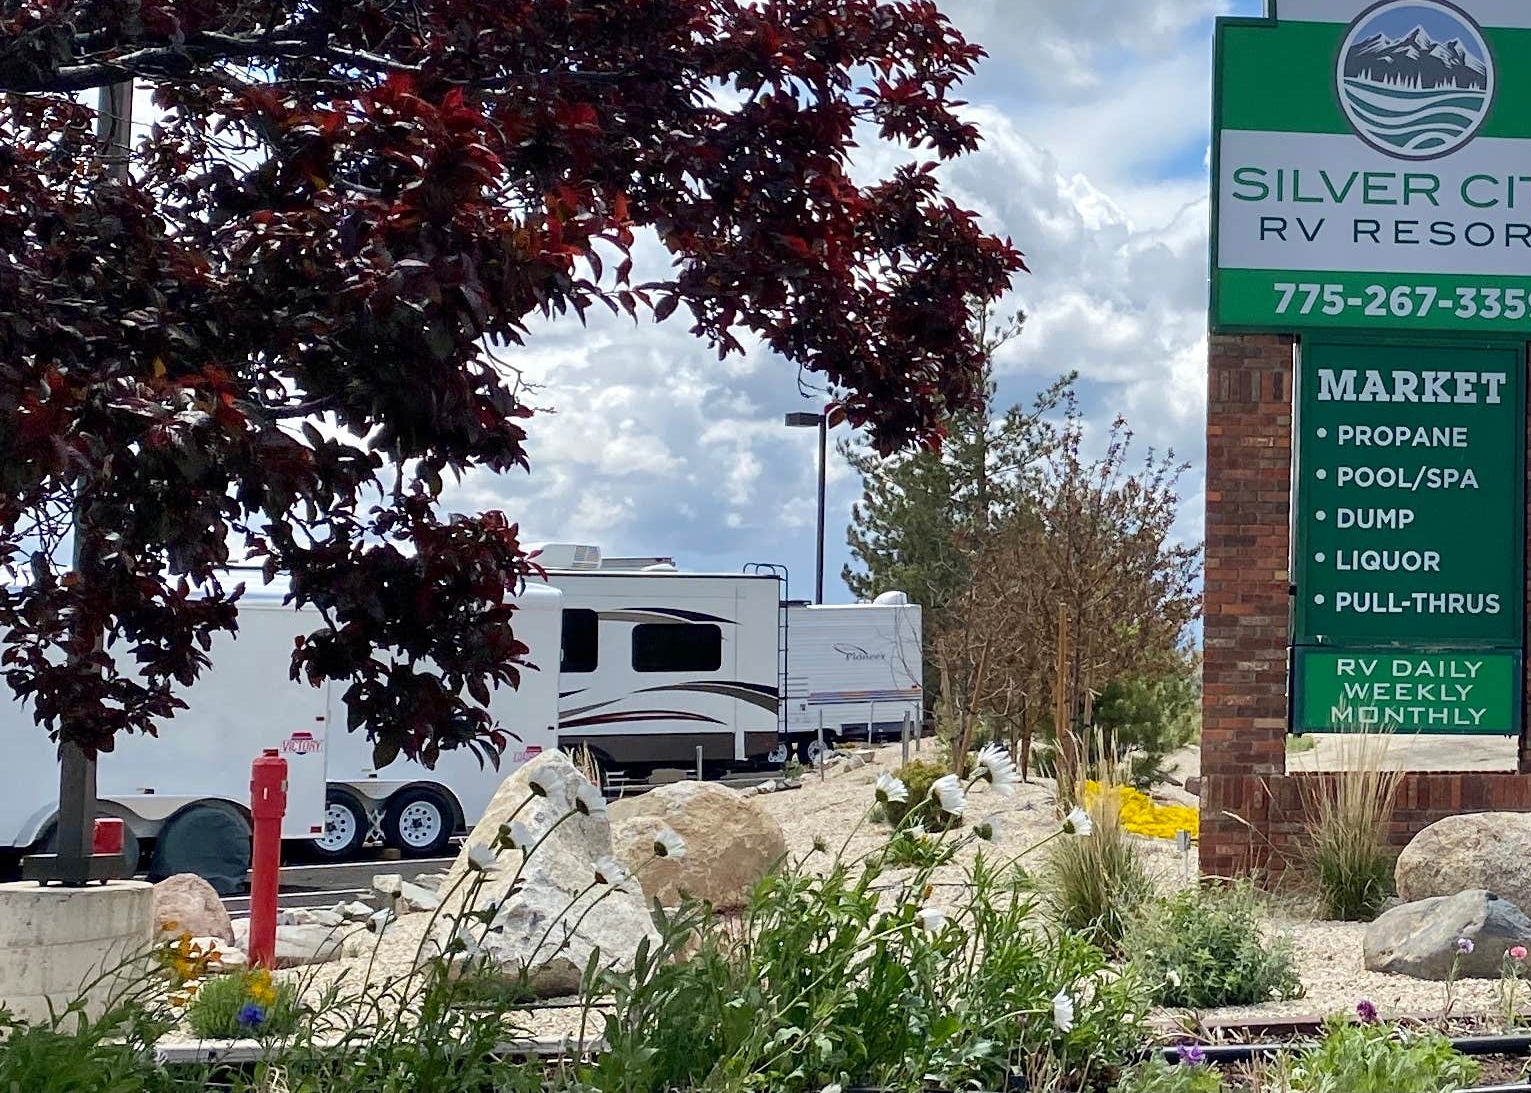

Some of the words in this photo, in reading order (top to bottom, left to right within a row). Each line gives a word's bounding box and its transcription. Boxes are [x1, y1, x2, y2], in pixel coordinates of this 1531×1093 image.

[1231, 166, 1441, 207] SILVER
[1259, 216, 1326, 242] RV
[1317, 369, 1507, 404] MARKET
[1337, 425, 1469, 448] PROPANE
[1336, 465, 1480, 491] POOL/SPA
[1336, 508, 1415, 530] DUMP
[1336, 550, 1441, 573] LIQUOR
[1335, 592, 1501, 614] PULL-THRUS
[1337, 658, 1378, 676] RV
[1392, 660, 1483, 678] DAILY
[1344, 682, 1473, 701] WEEKLY
[1331, 706, 1487, 725] MONTHLY
